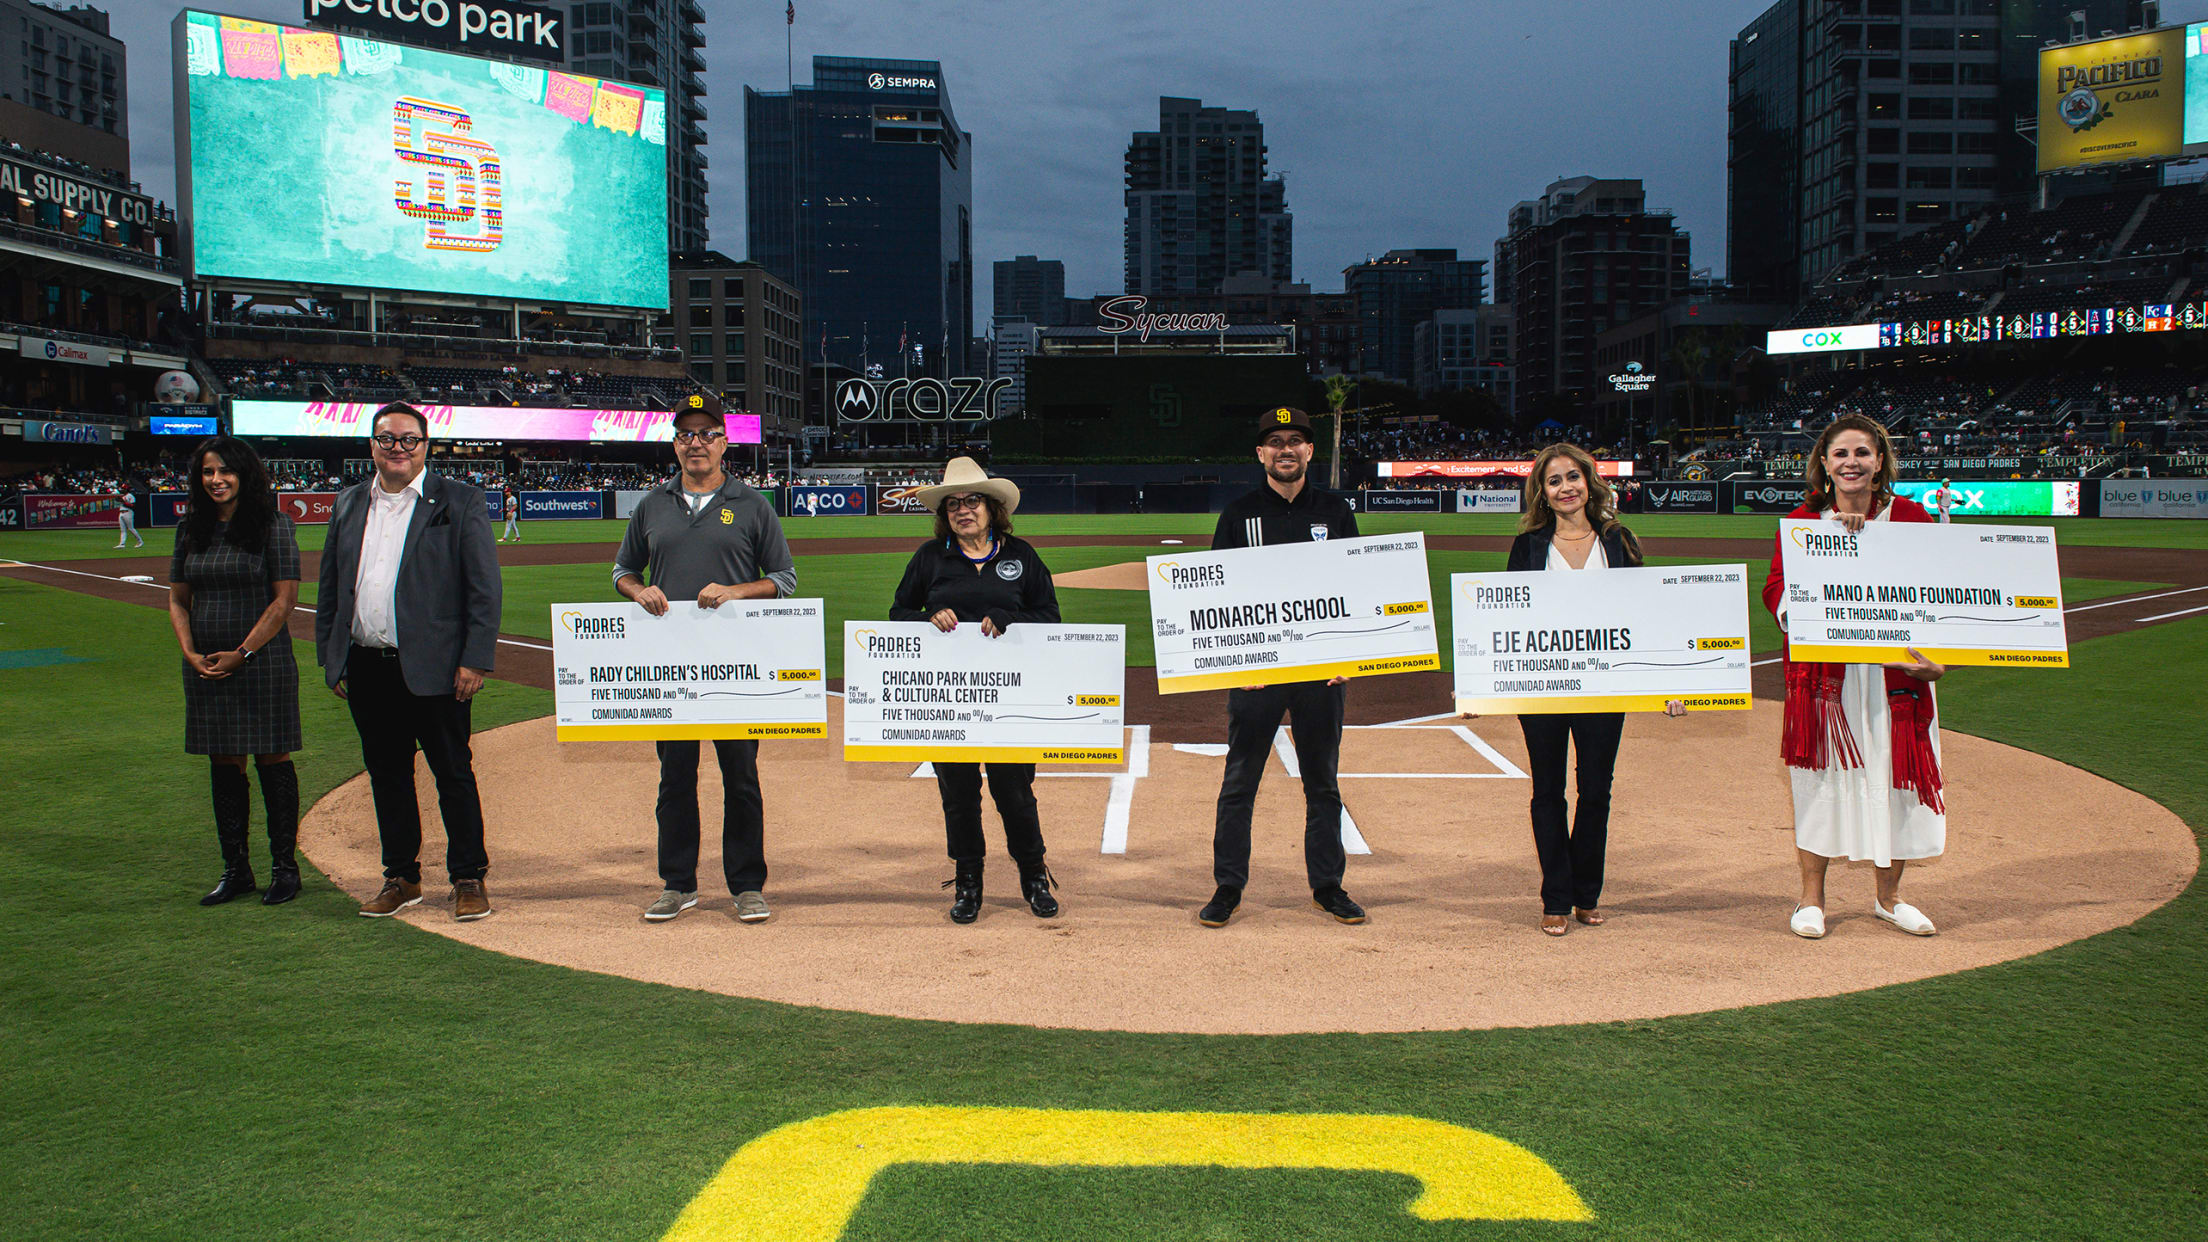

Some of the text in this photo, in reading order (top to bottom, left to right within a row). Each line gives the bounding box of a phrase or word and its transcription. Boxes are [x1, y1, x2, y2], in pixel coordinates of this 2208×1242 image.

[459, 1, 559, 49] park
[2058, 56, 2162, 93] PACIFICO
[888, 77, 936, 88] SEMPRA
[2115, 89, 2160, 102] CLARA
[34, 173, 112, 216] SUPPLY
[121, 198, 152, 227] CO.
[2106, 309, 2113, 320] 0
[2164, 304, 2172, 316] 4
[2186, 310, 2193, 322] 5
[1097, 295, 1230, 343] Sycuan
[1996, 316, 2003, 327] 2
[2051, 312, 2057, 324] 0
[2069, 317, 2077, 330] 5
[2126, 313, 2133, 326] 5
[2164, 318, 2172, 330] 2
[1895, 323, 1902, 334] 6
[1944, 320, 1951, 331] 6
[1963, 324, 1969, 336] 7
[2015, 321, 2022, 333] 8
[2050, 325, 2057, 337] 6
[2106, 321, 2113, 333] 3
[1803, 332, 1842, 346] COX
[1912, 329, 1919, 339] 9
[1944, 332, 1951, 343] 6
[1997, 328, 2002, 340] 1
[1895, 335, 1901, 346] 2
[58, 346, 88, 360] Calimax
[1608, 374, 1656, 383] Gallagher
[1615, 383, 1649, 392] Square
[881, 377, 1014, 422] razr
[1277, 408, 1291, 423] SD
[1451, 465, 1495, 473] Excitement
[1763, 461, 1808, 471] TEMPLE
[1895, 460, 1921, 468] ISKEY
[1944, 460, 1960, 468] SAN
[1962, 460, 1985, 468] DIEGO
[1988, 459, 2020, 468] PADRES
[795, 494, 845, 508] ACO
[1394, 497, 1414, 506] Diego
[1480, 495, 1516, 503] National
[1671, 490, 1690, 502] AIR
[2104, 490, 2137, 501] blue
[2158, 490, 2192, 501] blue
[526, 500, 589, 512] Southwest
[1806, 533, 1858, 551] PADRES
[1996, 534, 2026, 543] SEPTEMBER
[1364, 544, 1395, 553] SEPTEMBER
[1404, 542, 1418, 550] 2023
[1172, 564, 1224, 583] PADRES
[1681, 575, 1713, 583] SEPTEMBER
[1724, 574, 1740, 582] 2023
[1173, 580, 1225, 590] FOUNDATION
[1476, 586, 1530, 602] PADRES
[1824, 584, 2001, 606] MANO A MANO FOUNDATION
[2006, 596, 2013, 606] $
[1189, 596, 1350, 632] MONARCH SCHOOL
[1375, 606, 1382, 616] $
[1825, 607, 1845, 620] FIVE
[1847, 608, 1898, 622] THOUSAND
[1900, 612, 1914, 622] AND
[575, 617, 625, 633] PADRES
[1492, 628, 1632, 653] EJE ACADEMIES
[1827, 628, 1910, 642] COMUNIDAD AWARDS
[1193, 636, 1212, 650] FIVE
[1214, 633, 1265, 648] THOUSAND
[1267, 634, 1281, 643] AND
[1688, 639, 1695, 650] $
[1194, 651, 1278, 669] COMUNIDAD AWARDS
[1989, 654, 2006, 662] SAN
[1376, 662, 1401, 670] DIEGO
[1403, 659, 1434, 668] PADRES
[590, 664, 761, 683] RADY CHILDREN'S HOSPITAL
[768, 670, 775, 680] $
[882, 671, 1021, 687] CHICANO PARK MUSEUM
[591, 688, 610, 700] FIVE
[612, 687, 661, 700] THOUSAND
[663, 691, 676, 699] AND
[882, 688, 999, 703] & CULTURAL CENTER
[882, 728, 966, 741] COMUNIDAD AWARDS
[1086, 752, 1117, 760] PADRES
